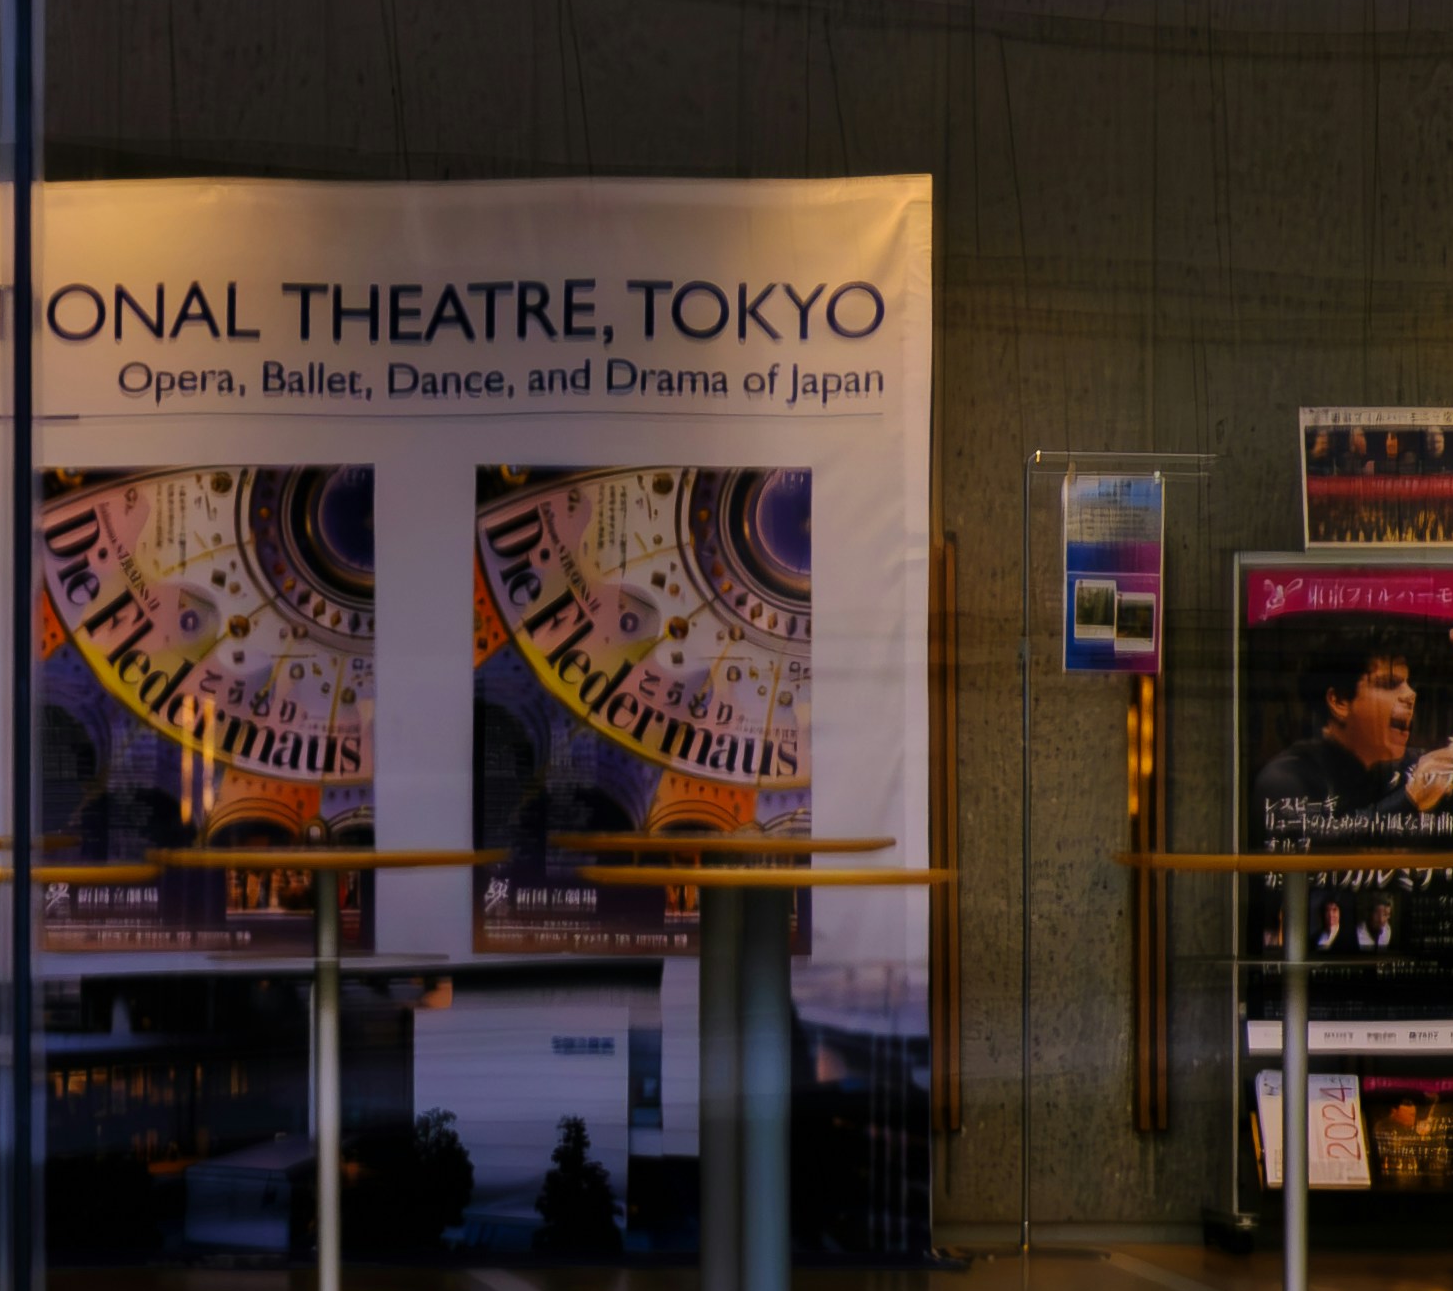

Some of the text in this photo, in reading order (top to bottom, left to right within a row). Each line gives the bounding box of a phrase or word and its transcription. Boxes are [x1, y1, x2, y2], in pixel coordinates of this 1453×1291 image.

[281, 277, 616, 347] THEATRE,
[626, 277, 886, 344] TOKYO
[117, 357, 885, 408] Opera, Ballet, Dance, and Drama of Japan
[43, 506, 109, 606] Die
[83, 588, 363, 776] Fledermaus
[484, 506, 551, 607] Die
[523, 589, 800, 778] Fledermaus
[1319, 1077, 1362, 1162] 2024
